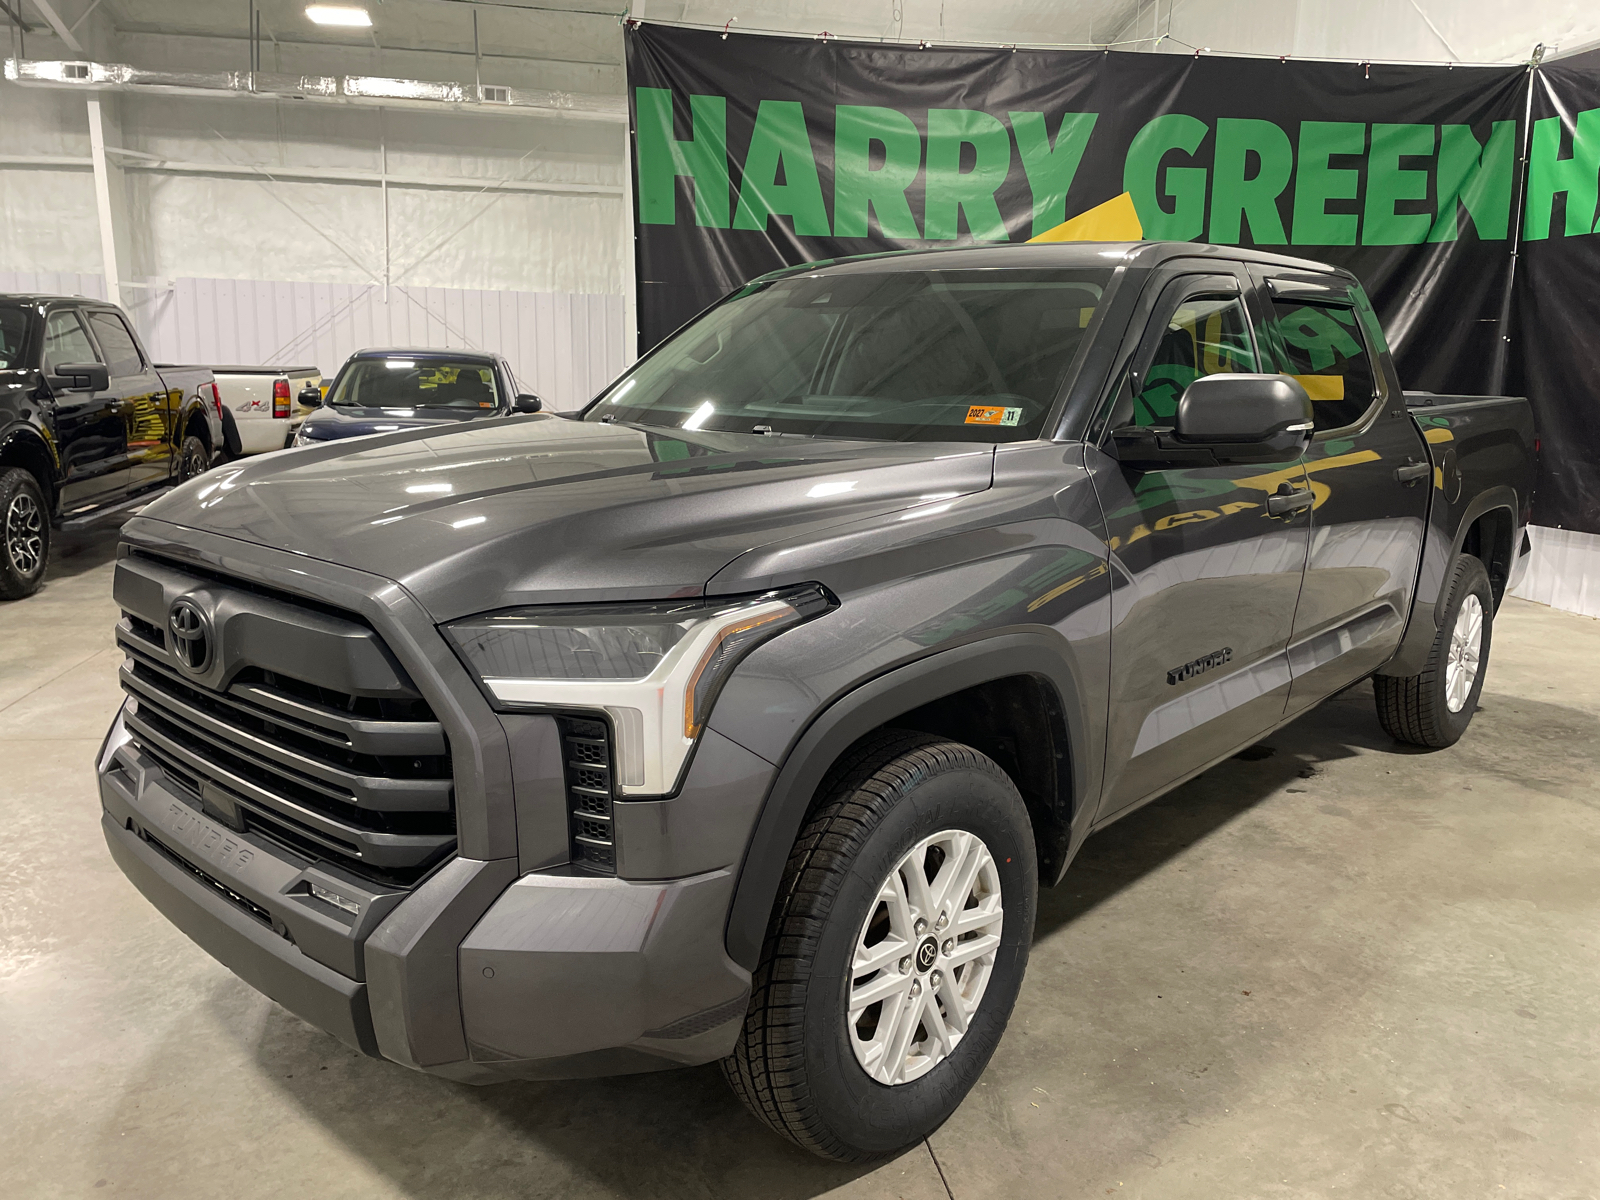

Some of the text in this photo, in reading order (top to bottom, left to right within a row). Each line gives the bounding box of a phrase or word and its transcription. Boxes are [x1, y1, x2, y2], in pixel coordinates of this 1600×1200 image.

[635, 87, 1517, 245] HARRY GREEN
[1522, 108, 1600, 242] H
[968, 408, 985, 418] 2027
[1007, 410, 1015, 421] 11
[1166, 647, 1233, 686] TUNDRA
[161, 804, 255, 874] TUNDRA
